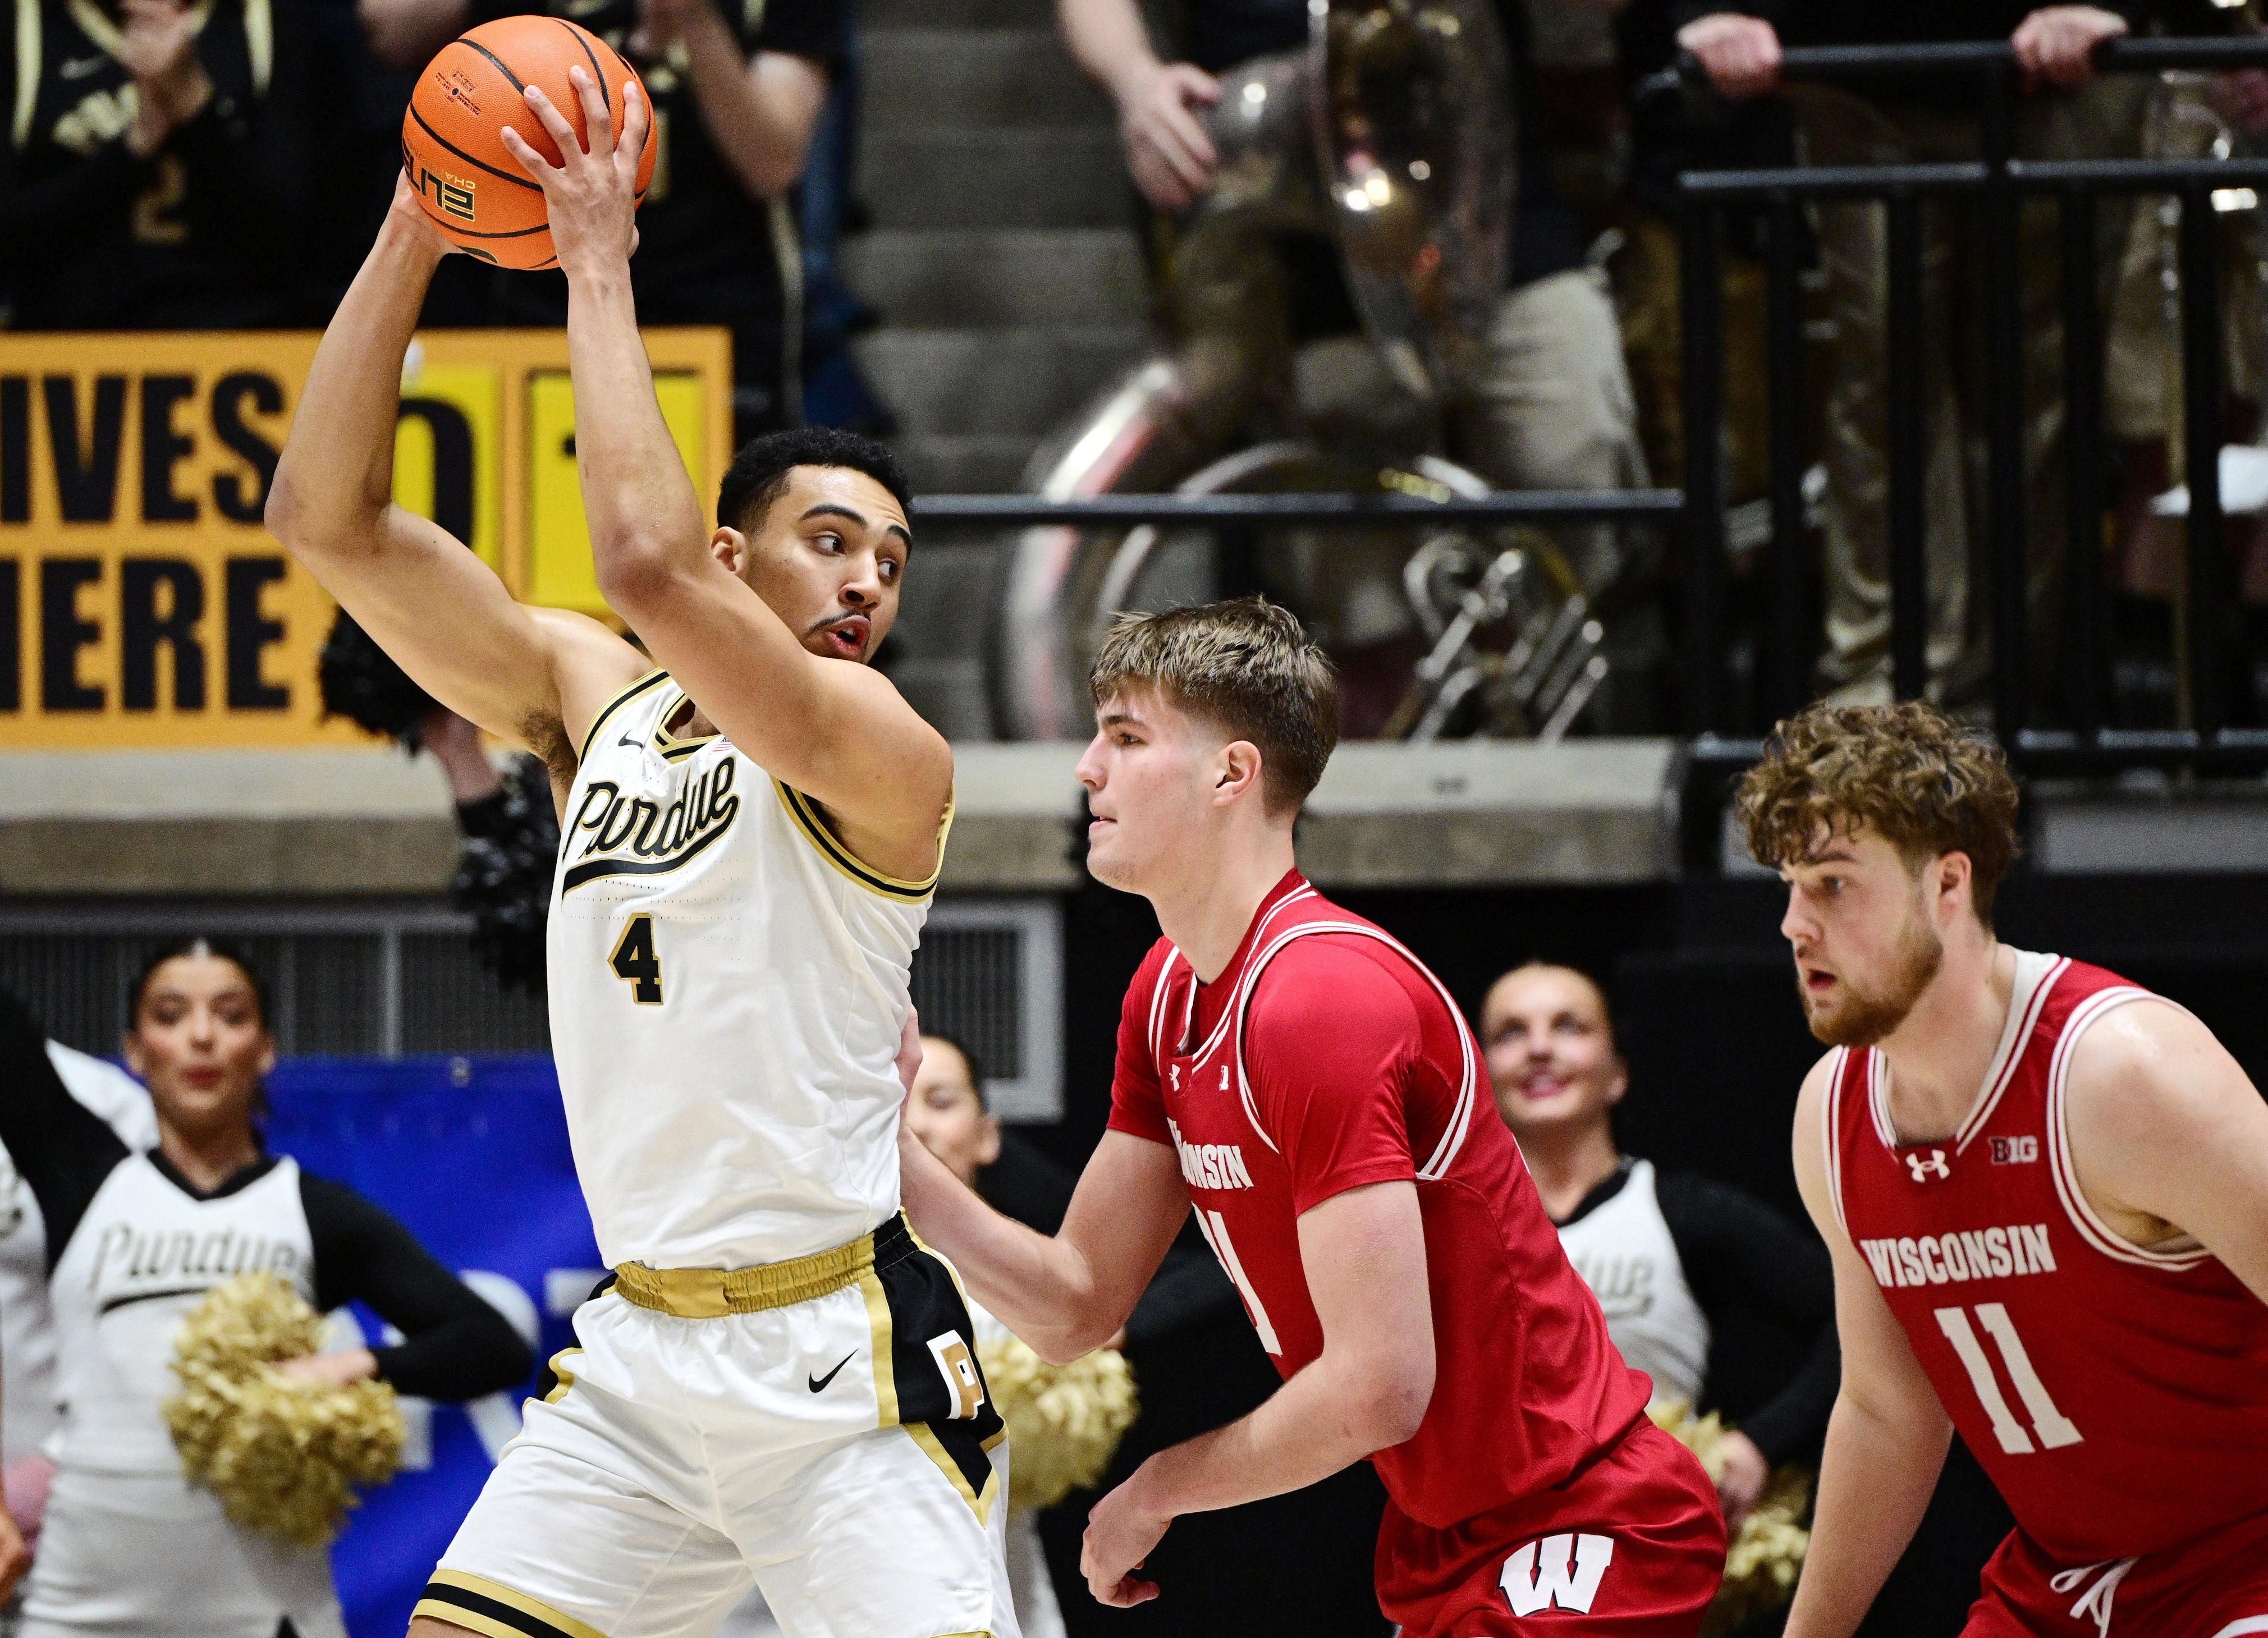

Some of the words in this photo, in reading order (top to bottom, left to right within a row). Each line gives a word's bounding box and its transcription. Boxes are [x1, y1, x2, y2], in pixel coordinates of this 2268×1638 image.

[562, 755, 740, 863] Purdue
[607, 912, 663, 1005] 4
[1860, 1223, 2058, 1288] WISCONSIN
[1933, 1302, 2084, 1455] 11
[1496, 1533, 1614, 1618] W
